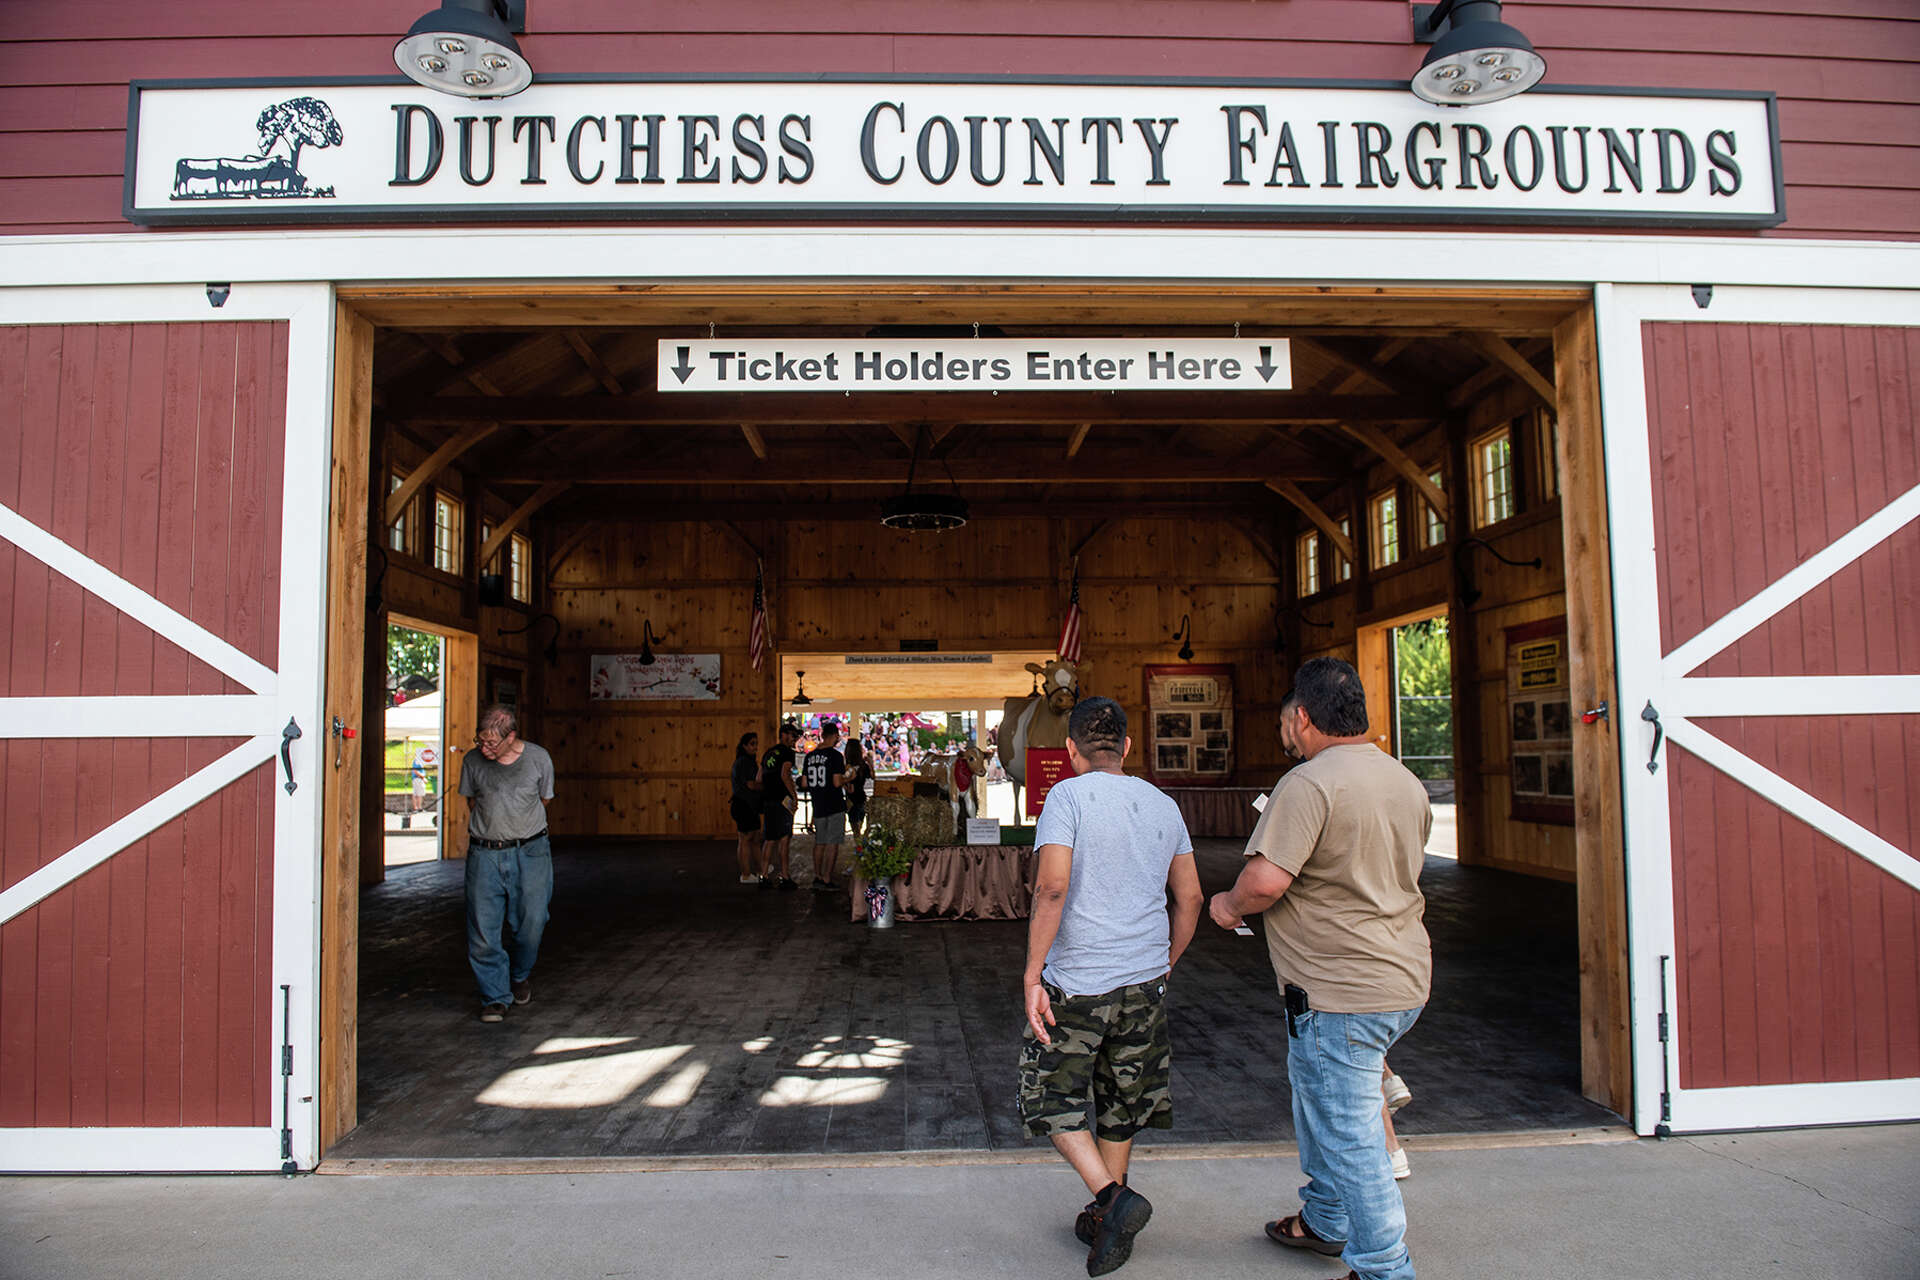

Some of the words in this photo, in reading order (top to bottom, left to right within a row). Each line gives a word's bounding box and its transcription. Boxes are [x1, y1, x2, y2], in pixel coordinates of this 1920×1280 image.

[389, 104, 814, 187] DUTCHESS
[860, 101, 1179, 187] COUNTY
[1219, 104, 1743, 197] FAIRGROUNDS
[709, 351, 839, 381] Ticket
[854, 351, 1011, 381] Holders
[1026, 351, 1135, 381] Enter
[1148, 351, 1241, 380] Here
[808, 766, 827, 788] 99
